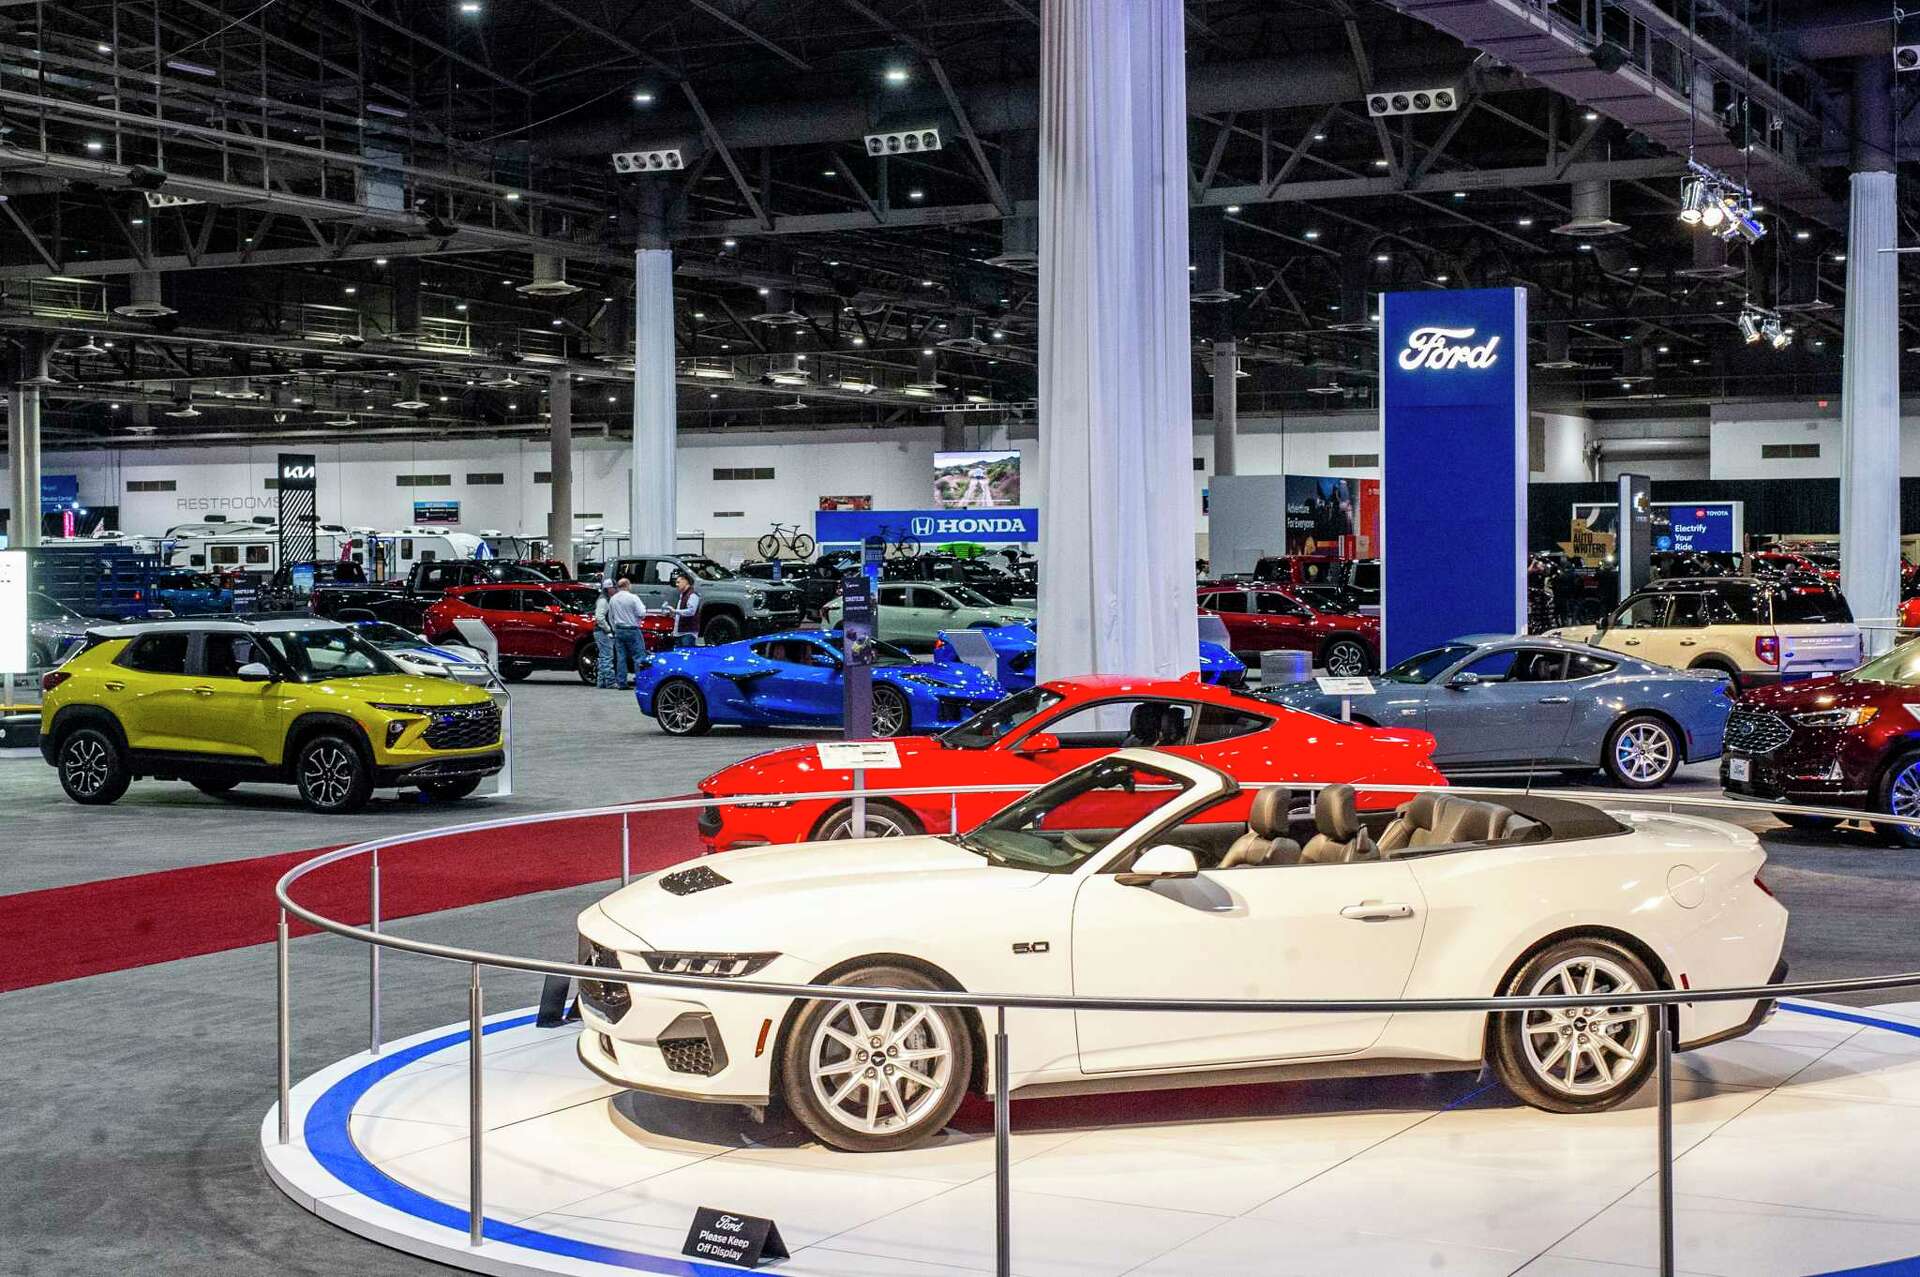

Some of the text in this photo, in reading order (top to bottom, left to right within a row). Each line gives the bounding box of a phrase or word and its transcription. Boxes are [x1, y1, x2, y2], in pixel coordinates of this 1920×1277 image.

[1399, 327, 1500, 370] Ford
[177, 496, 279, 510] RESTROOMS
[936, 518, 1026, 534] HONDA
[1674, 523, 1707, 534] Electrify
[1674, 534, 1693, 542] Your
[1674, 542, 1693, 551] Ride
[1012, 941, 1050, 954] 5.0
[715, 1215, 744, 1232] Ford
[699, 1230, 750, 1249] Please Keep
[696, 1242, 743, 1261] Off Display
